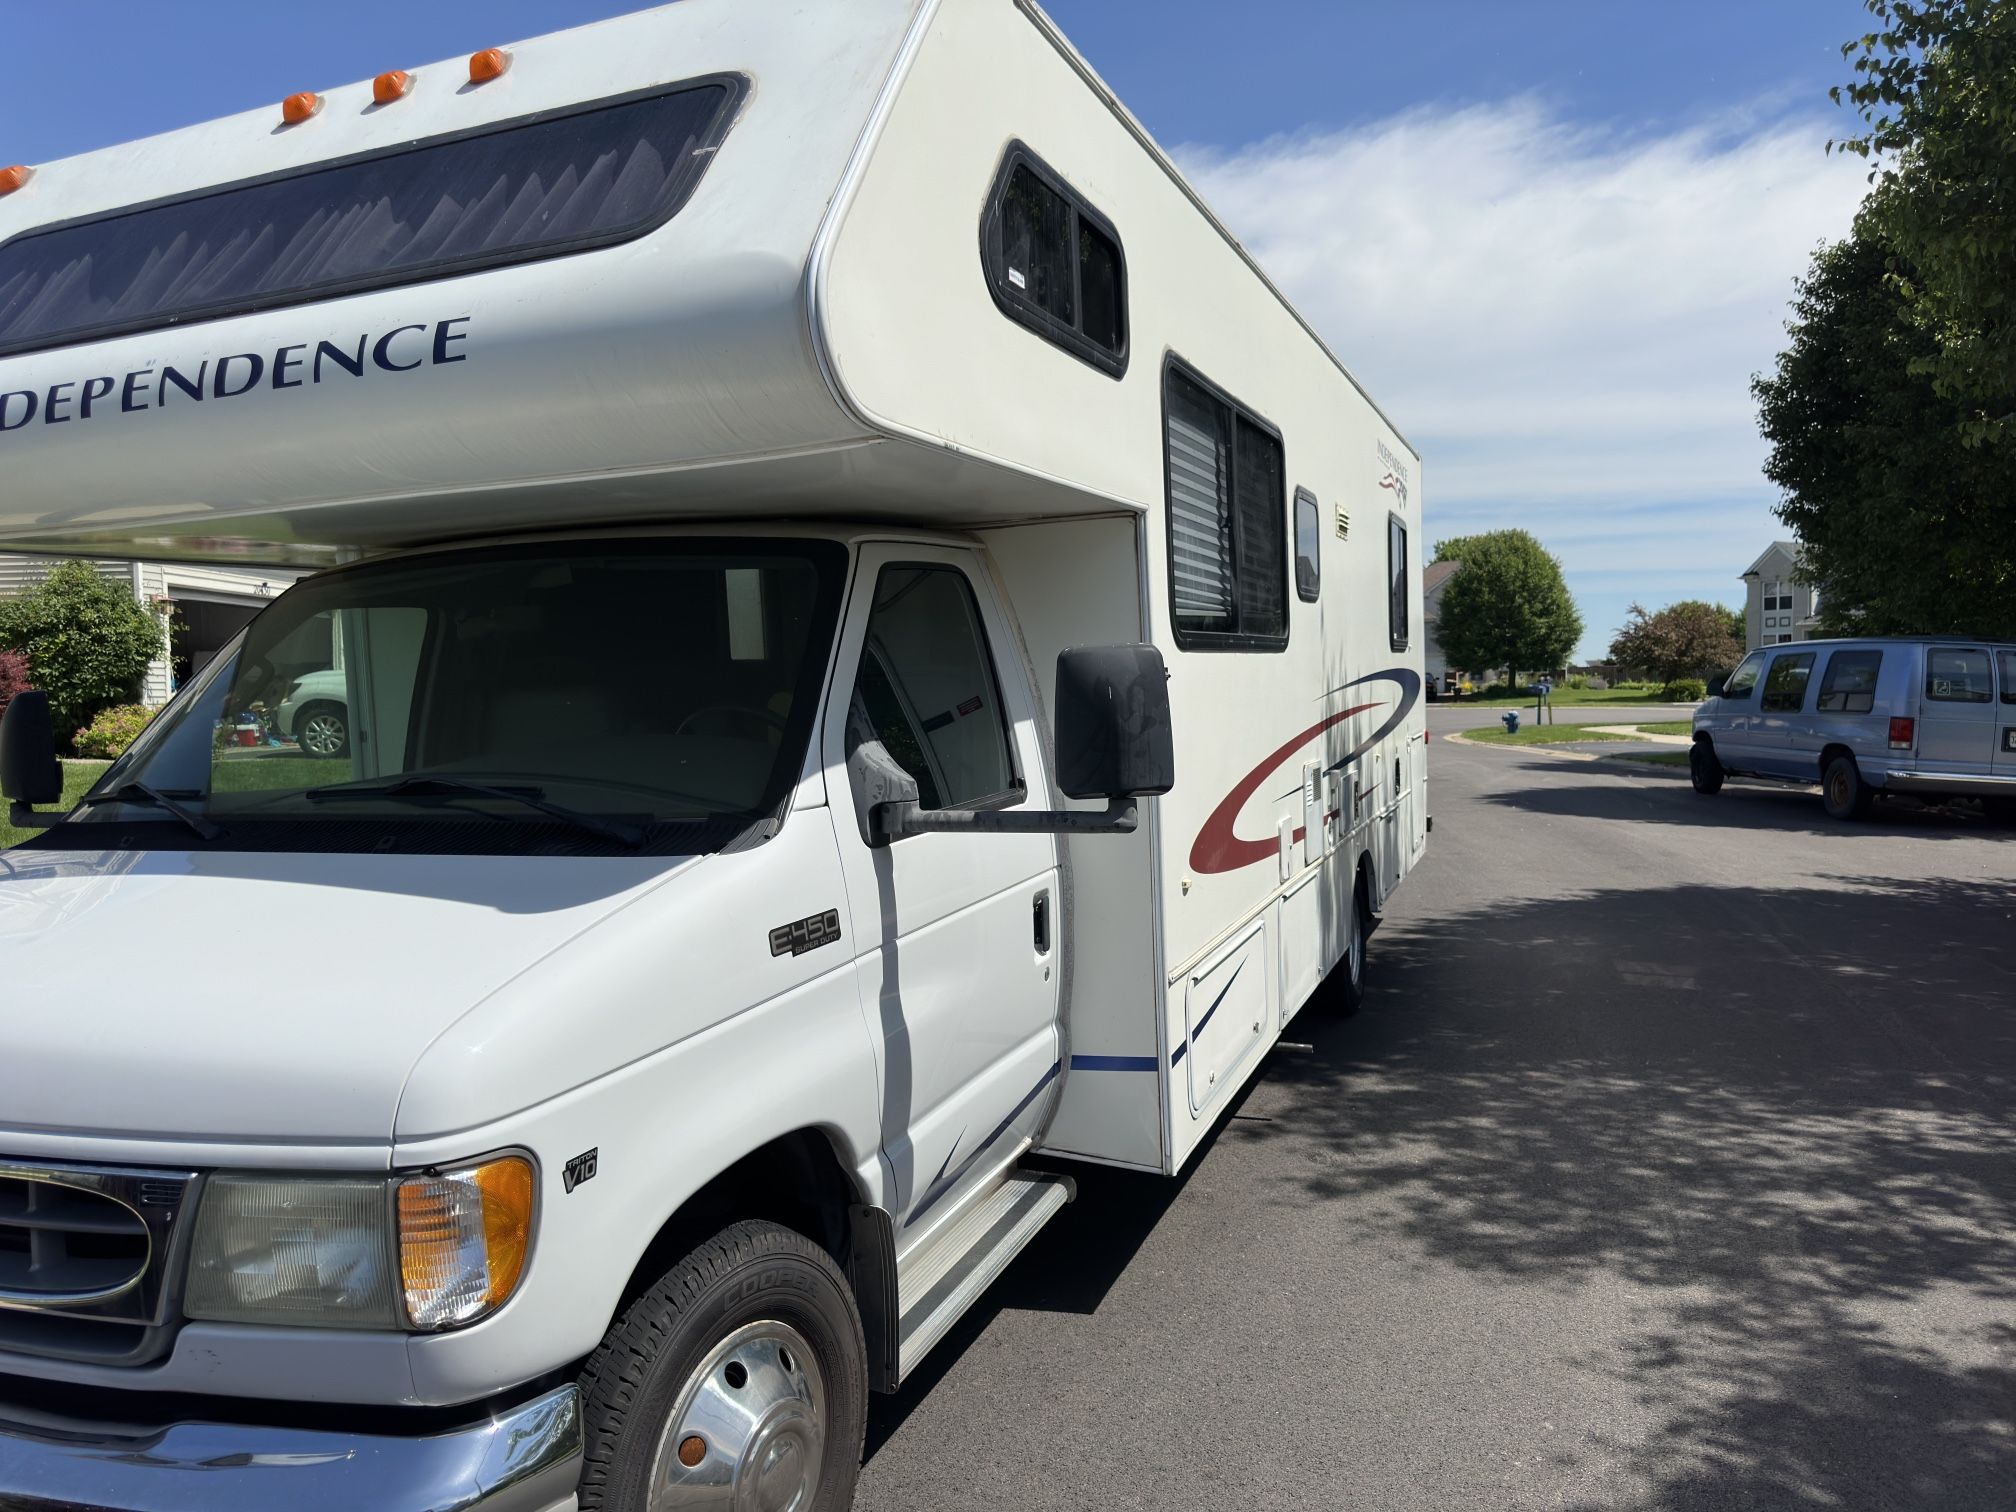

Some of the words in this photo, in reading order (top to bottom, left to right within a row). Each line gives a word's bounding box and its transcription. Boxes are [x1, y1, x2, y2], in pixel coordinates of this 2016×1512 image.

[0, 316, 471, 431] DEPENDENCE
[795, 939, 819, 954] SUPER
[820, 931, 839, 944] DUTY
[567, 1149, 597, 1169] TRITON
[564, 1159, 597, 1192] V10
